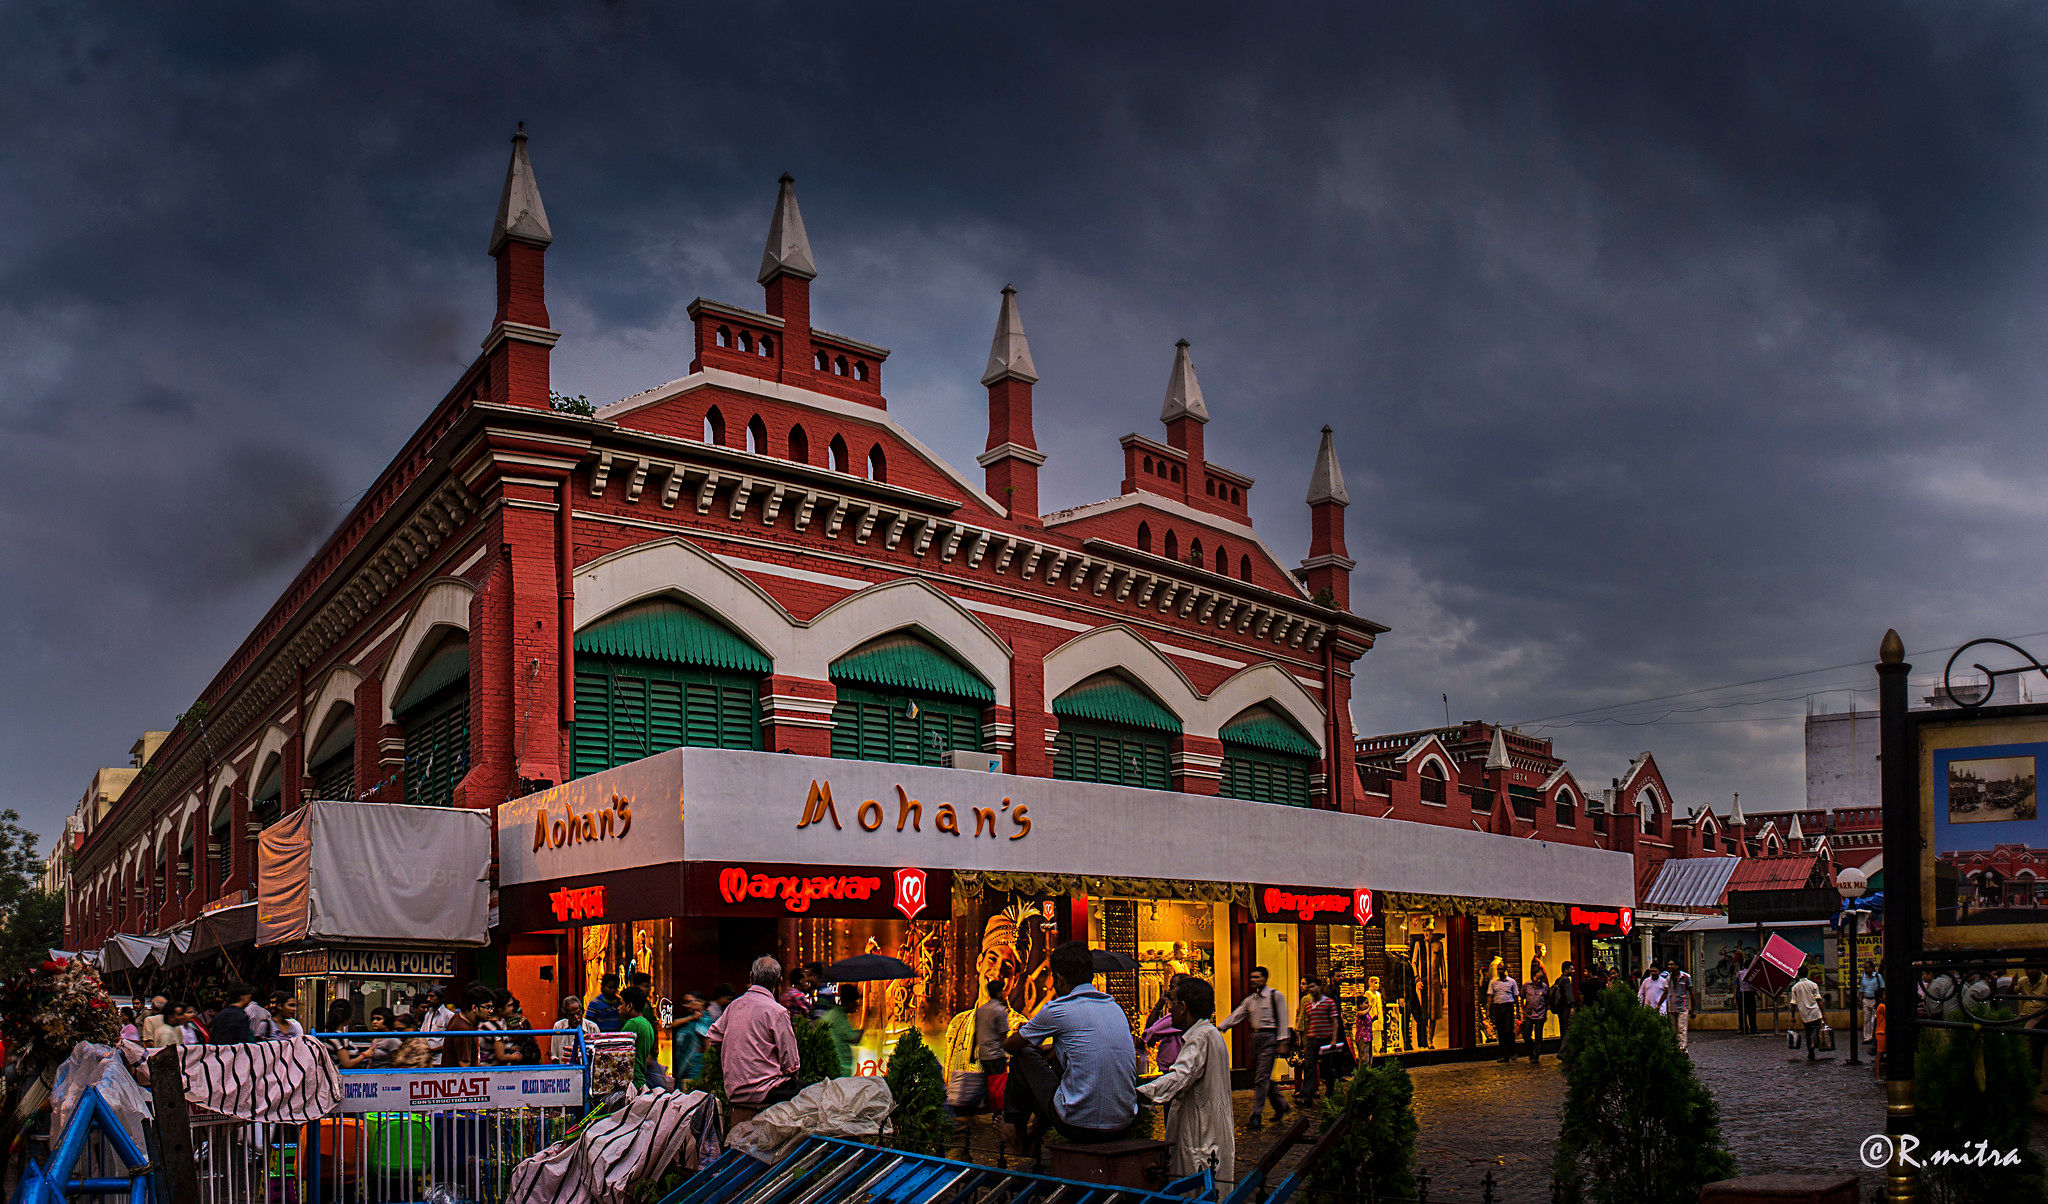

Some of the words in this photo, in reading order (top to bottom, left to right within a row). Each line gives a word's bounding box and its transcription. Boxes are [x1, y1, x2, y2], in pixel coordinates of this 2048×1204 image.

[797, 778, 1032, 840] Mohan's
[533, 792, 632, 853] Mohan's
[719, 867, 881, 913] Manyavar
[1264, 887, 1351, 921] Manyavar
[330, 951, 396, 972] KOLKATA
[401, 954, 452, 974] POLICE
[344, 1083, 362, 1099] TRAFFIC
[363, 1082, 378, 1098] POLICE
[409, 1077, 490, 1100] CONCAST
[522, 1079, 539, 1095] KOLKATA
[540, 1079, 555, 1094] TRAFFIC
[556, 1078, 571, 1093] POLICE
[411, 1097, 467, 1105] CONSTRUCTION
